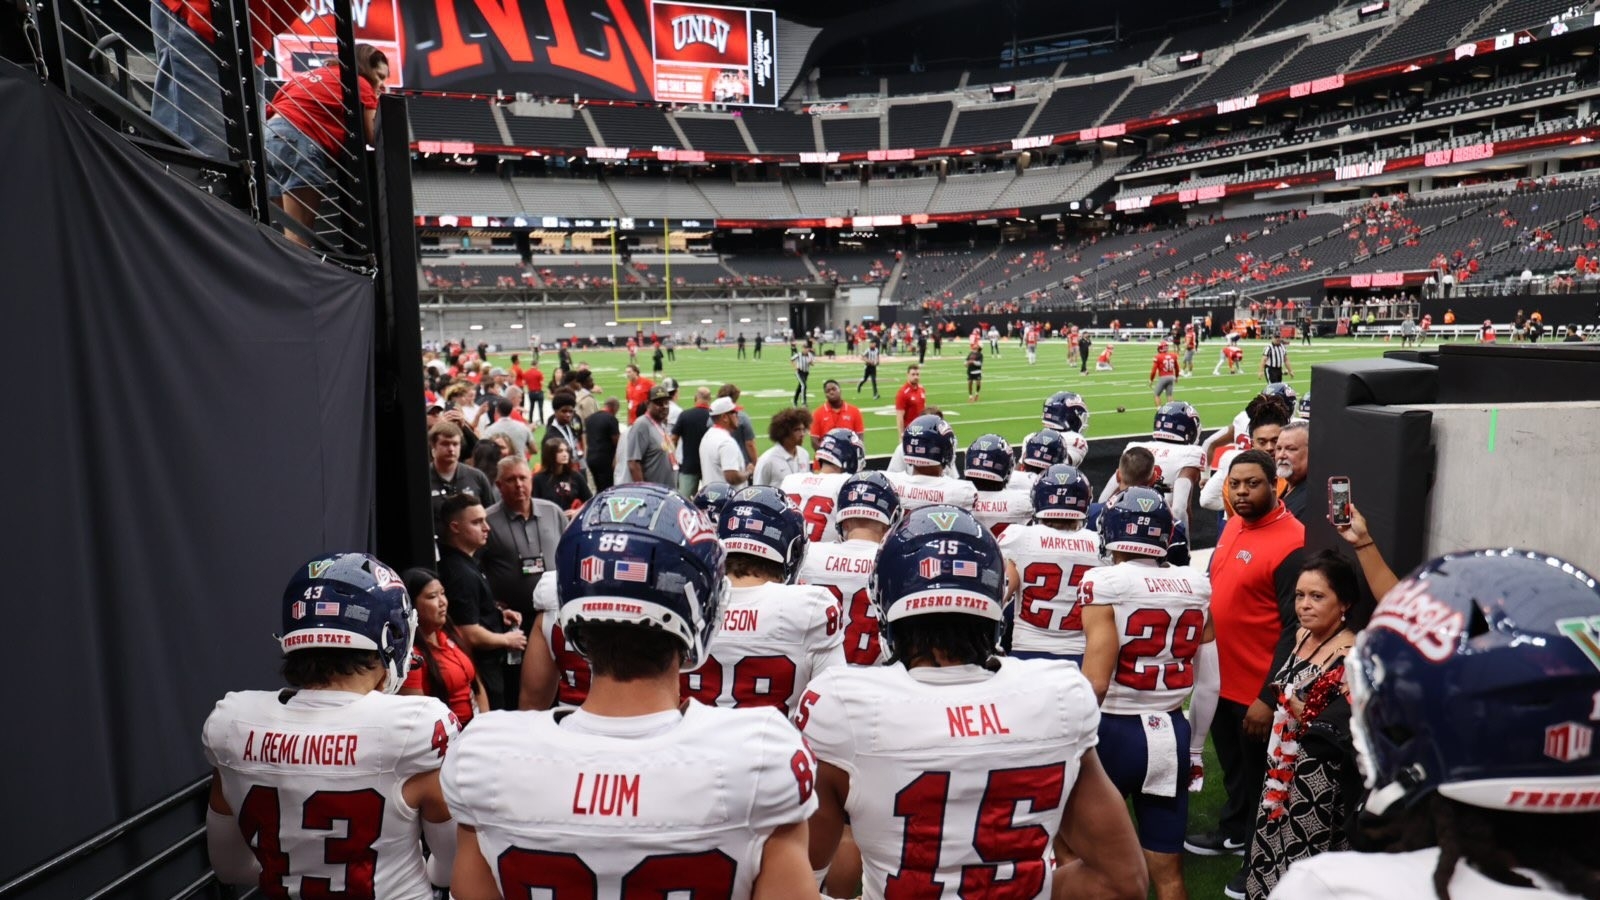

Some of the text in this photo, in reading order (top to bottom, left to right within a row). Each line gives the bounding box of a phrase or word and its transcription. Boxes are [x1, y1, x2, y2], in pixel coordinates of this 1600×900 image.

[671, 13, 730, 54] UNLV
[755, 29, 765, 87] AMERICA FIRST
[907, 488, 944, 503] JOHNSON
[975, 500, 1008, 512] ENEAUX
[1137, 516, 1150, 525] 29
[599, 534, 629, 552] 89
[743, 543, 767, 554] STATE
[937, 541, 959, 555] 15
[1040, 536, 1095, 553] WARKENTIN
[303, 586, 323, 600] 43
[1144, 577, 1193, 593] CARRILLO
[905, 596, 989, 611] FRESNO STATE
[1019, 562, 1092, 631] 27
[582, 603, 643, 614] FRESNO STATE
[722, 609, 758, 632] RSON
[284, 634, 351, 647] FRESNO STATE
[1115, 608, 1204, 691] 29
[945, 703, 1010, 738] NEAL
[572, 772, 640, 817] LIUM
[1507, 791, 1600, 807] FRESN
[884, 761, 1066, 900] 15
[238, 784, 386, 900] 43
